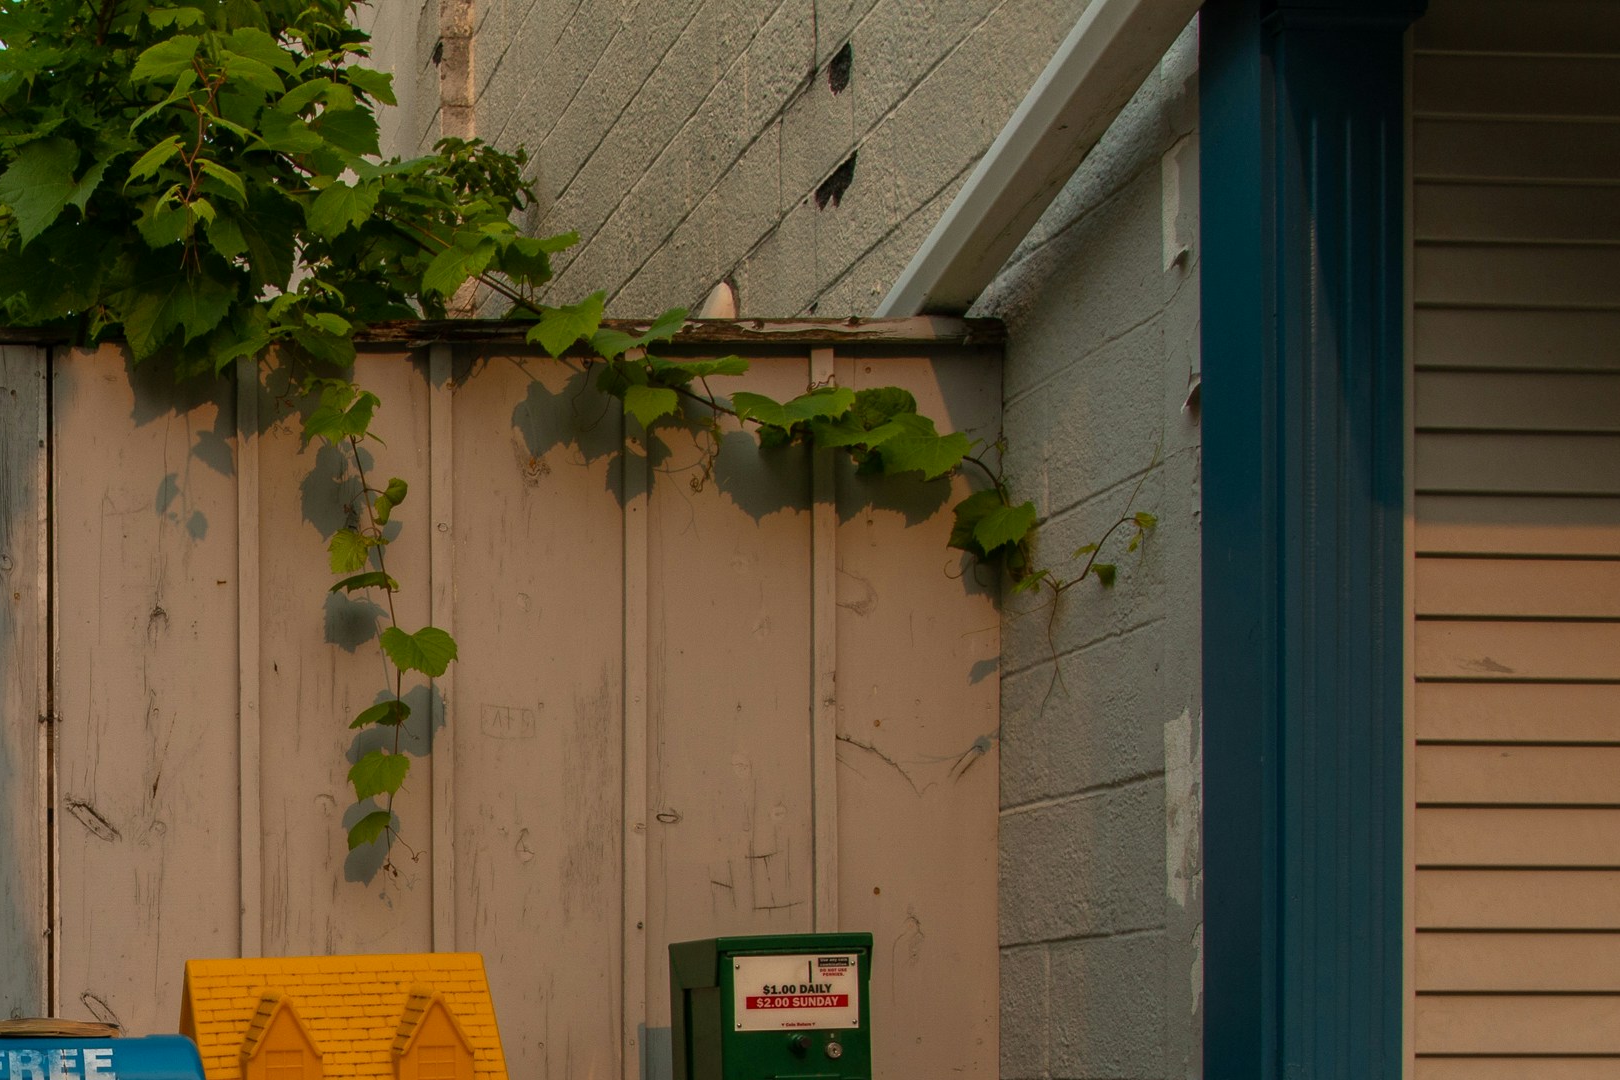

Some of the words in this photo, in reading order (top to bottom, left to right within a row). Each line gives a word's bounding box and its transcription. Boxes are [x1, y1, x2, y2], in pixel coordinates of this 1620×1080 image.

[763, 984, 796, 994] $1.00
[800, 984, 832, 994] DAILY
[756, 998, 790, 1008] $2.00
[792, 996, 838, 1007] SUNDAY
